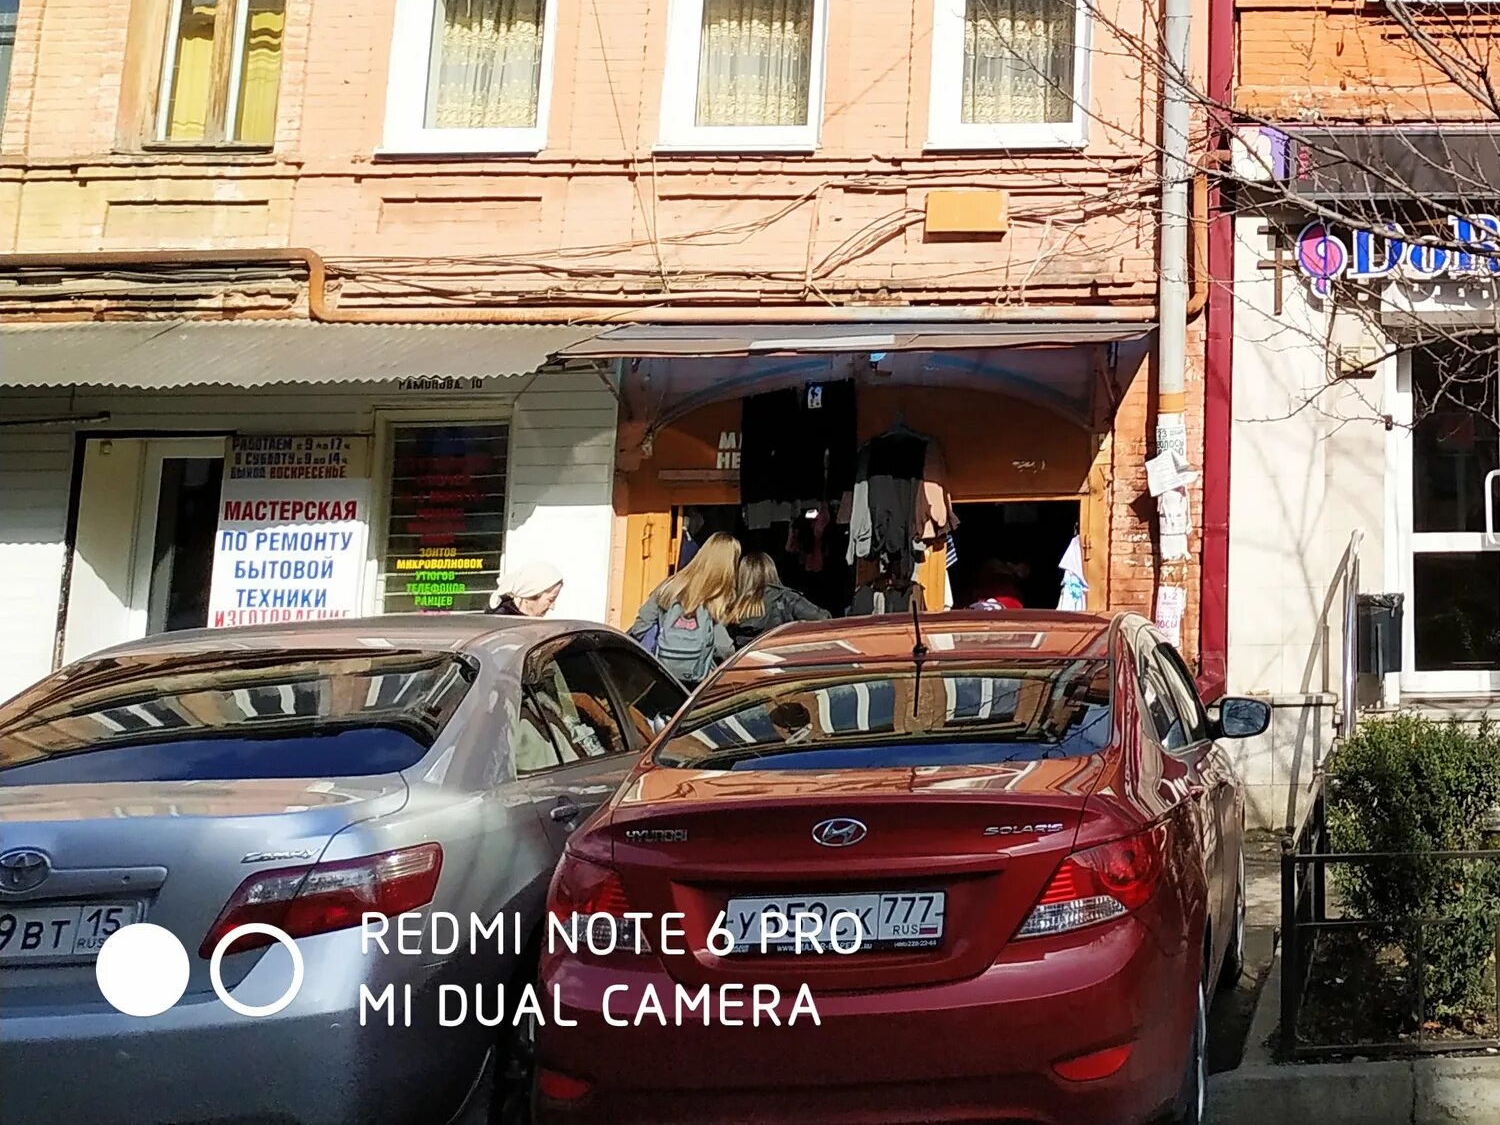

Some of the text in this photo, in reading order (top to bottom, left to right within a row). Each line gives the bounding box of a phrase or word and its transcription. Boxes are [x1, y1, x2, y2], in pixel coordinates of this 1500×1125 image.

[330, 438, 343, 450] 17
[270, 465, 347, 479] ВОСКРЕСЕНЬЕ
[224, 500, 357, 521] МАСТЕРСКАЯ
[221, 531, 353, 551] ПО РЕМОНТУ
[420, 547, 457, 557] ЗОНТОВ
[234, 556, 334, 579] БЫТОВОЙ
[396, 558, 483, 569] МИКРОВОЛНОВОК
[415, 571, 455, 581] УТЮГОВ
[407, 583, 465, 593] ТЕЛЕФОНОВ
[236, 589, 327, 608] ТЕХНИКИ
[415, 595, 453, 607] РАНЦЕВ
[984, 823, 1064, 836] SOLARIS
[883, 896, 934, 924] 777
[86, 907, 123, 936] 15
[892, 924, 919, 935] RUS
